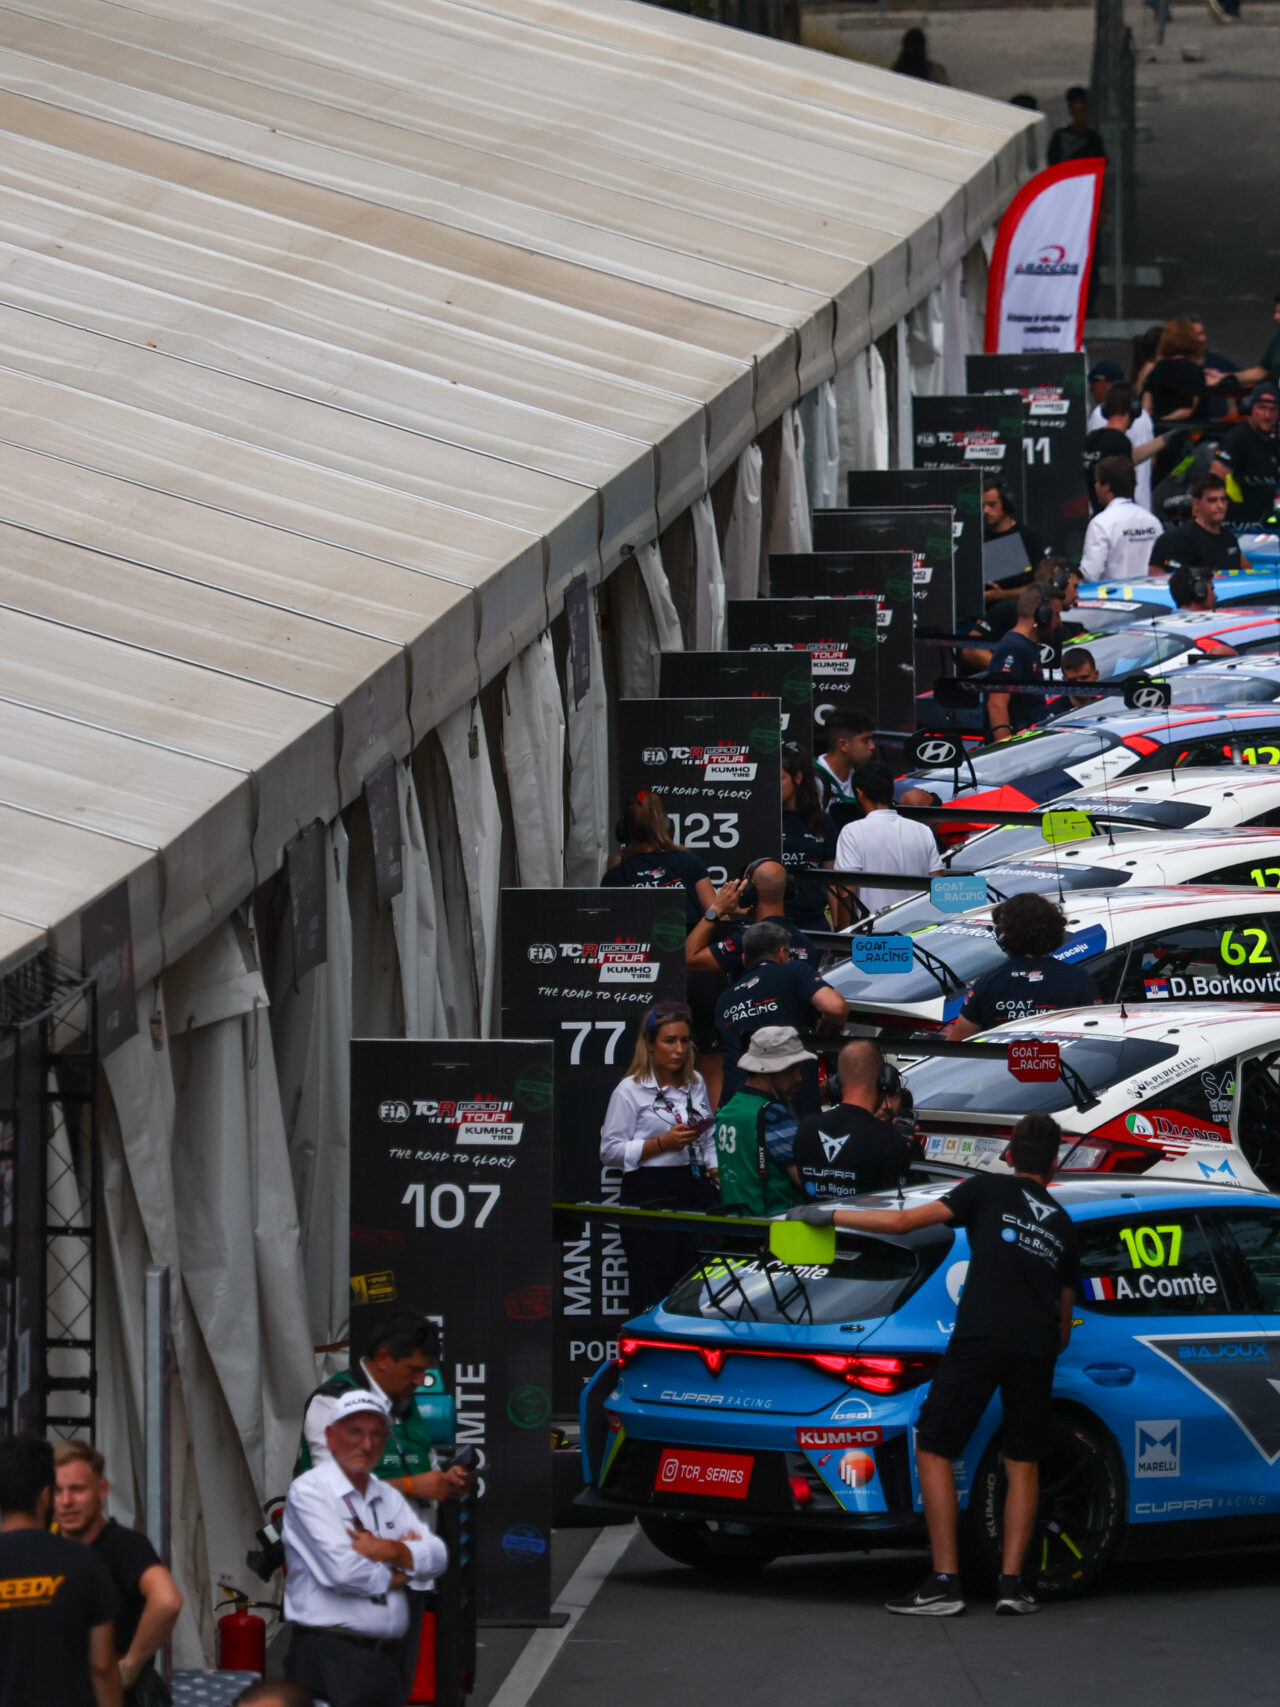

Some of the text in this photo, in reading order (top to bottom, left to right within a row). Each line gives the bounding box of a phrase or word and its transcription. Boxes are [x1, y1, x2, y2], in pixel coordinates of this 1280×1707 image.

[669, 747, 703, 759] TCR
[711, 755, 745, 763] TOUR
[650, 785, 752, 800] THE ROAD TO GLORY
[667, 813, 740, 849] 123
[934, 882, 964, 892] GOAT
[944, 891, 986, 901] RACING
[558, 943, 599, 957] TCR
[856, 941, 888, 951] GOAT
[1220, 928, 1273, 965] 62
[606, 954, 644, 962] TOUR
[865, 950, 909, 962] RACING
[538, 986, 653, 1004] THE ROAD TO GLORY
[723, 999, 752, 1019] GOAT
[732, 1001, 778, 1023] RACING
[996, 1000, 1034, 1011] GOAT
[561, 1021, 626, 1065] 77
[1011, 1047, 1039, 1057] GOAT
[1020, 1058, 1057, 1070] RACING
[1151, 1057, 1194, 1083] PURICELLI
[412, 1101, 456, 1116] TCR
[465, 1113, 506, 1122] TOUR
[465, 1127, 514, 1135] KUMHO
[718, 1124, 737, 1154] 93
[389, 1149, 516, 1168] THE ROAD TO GLORY
[802, 1166, 856, 1180] CUPRA
[815, 1182, 826, 1192] La
[400, 1183, 501, 1229] 107
[1002, 1213, 1065, 1253] CUPRA
[1019, 1232, 1030, 1244] La
[1119, 1225, 1182, 1269] 107
[1116, 1273, 1218, 1300] A.Comte
[1178, 1344, 1268, 1359] BIAJOUX
[660, 1390, 772, 1409] CUPRA RACING
[800, 1430, 879, 1445] KUMHO
[680, 1465, 744, 1484] TCR_SERIES
[1137, 1461, 1178, 1473] MARELLI
[1135, 1494, 1266, 1515] CUPRA RACING
